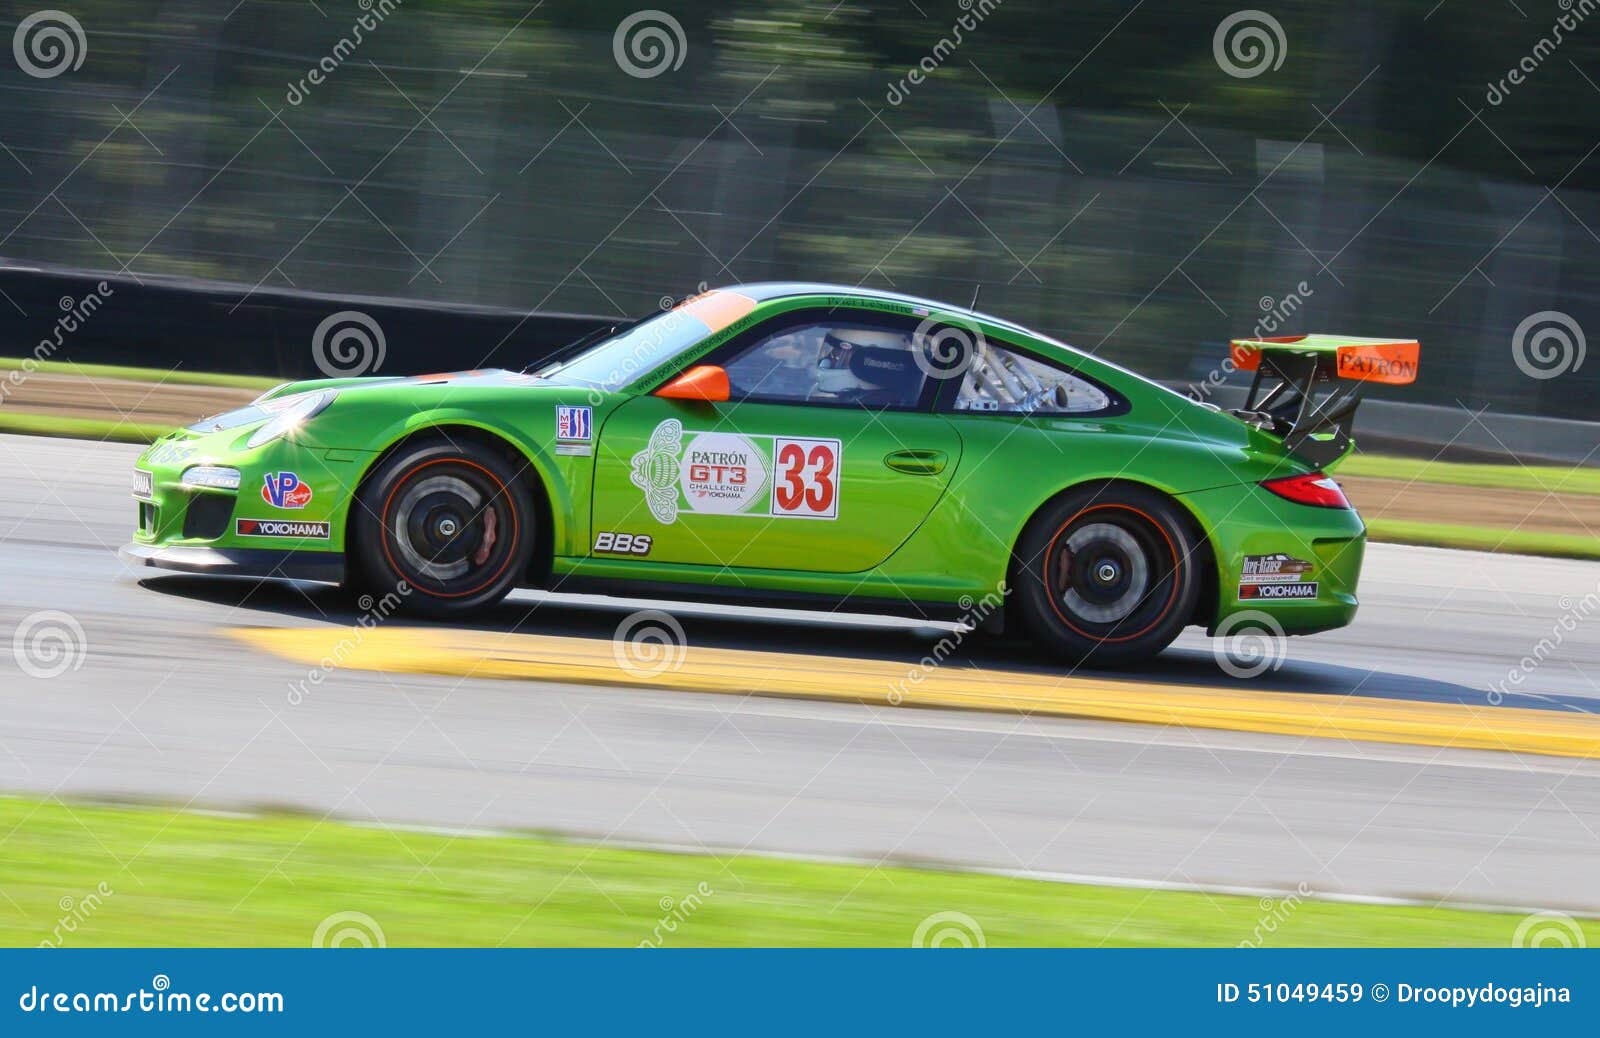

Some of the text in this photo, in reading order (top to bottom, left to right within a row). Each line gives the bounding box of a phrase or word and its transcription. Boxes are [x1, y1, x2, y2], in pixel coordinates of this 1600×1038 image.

[692, 450, 748, 466] PATRÓN
[690, 465, 747, 485] GT3
[776, 443, 835, 513] 33
[264, 471, 299, 508] VP
[689, 483, 746, 492] CHALLENGE
[258, 522, 325, 536] YOKOHAMA
[594, 532, 652, 554] BBS
[1258, 586, 1313, 597] YOKOHAMA
